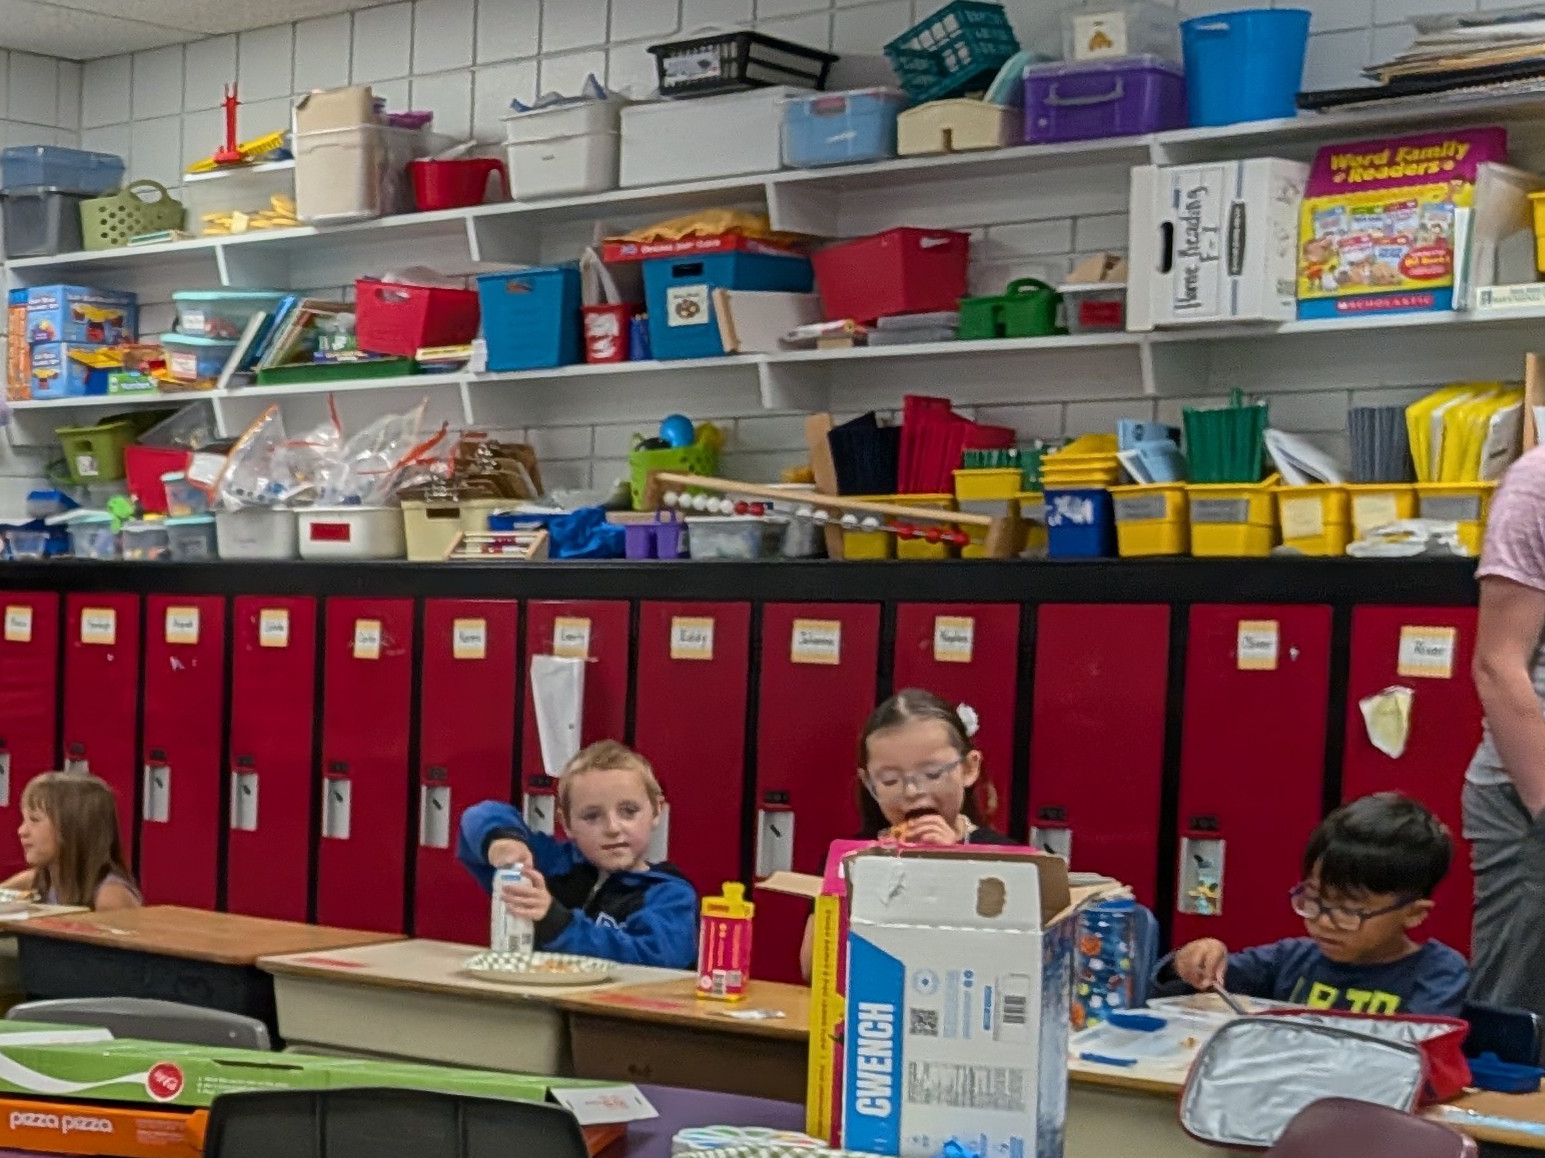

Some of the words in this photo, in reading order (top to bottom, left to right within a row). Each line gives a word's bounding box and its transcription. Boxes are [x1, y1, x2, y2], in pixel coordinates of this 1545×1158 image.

[1331, 149, 1390, 170] Word
[1396, 140, 1469, 163] Family
[1348, 161, 1440, 183] Readers
[855, 1001, 894, 1118] CWENCH
